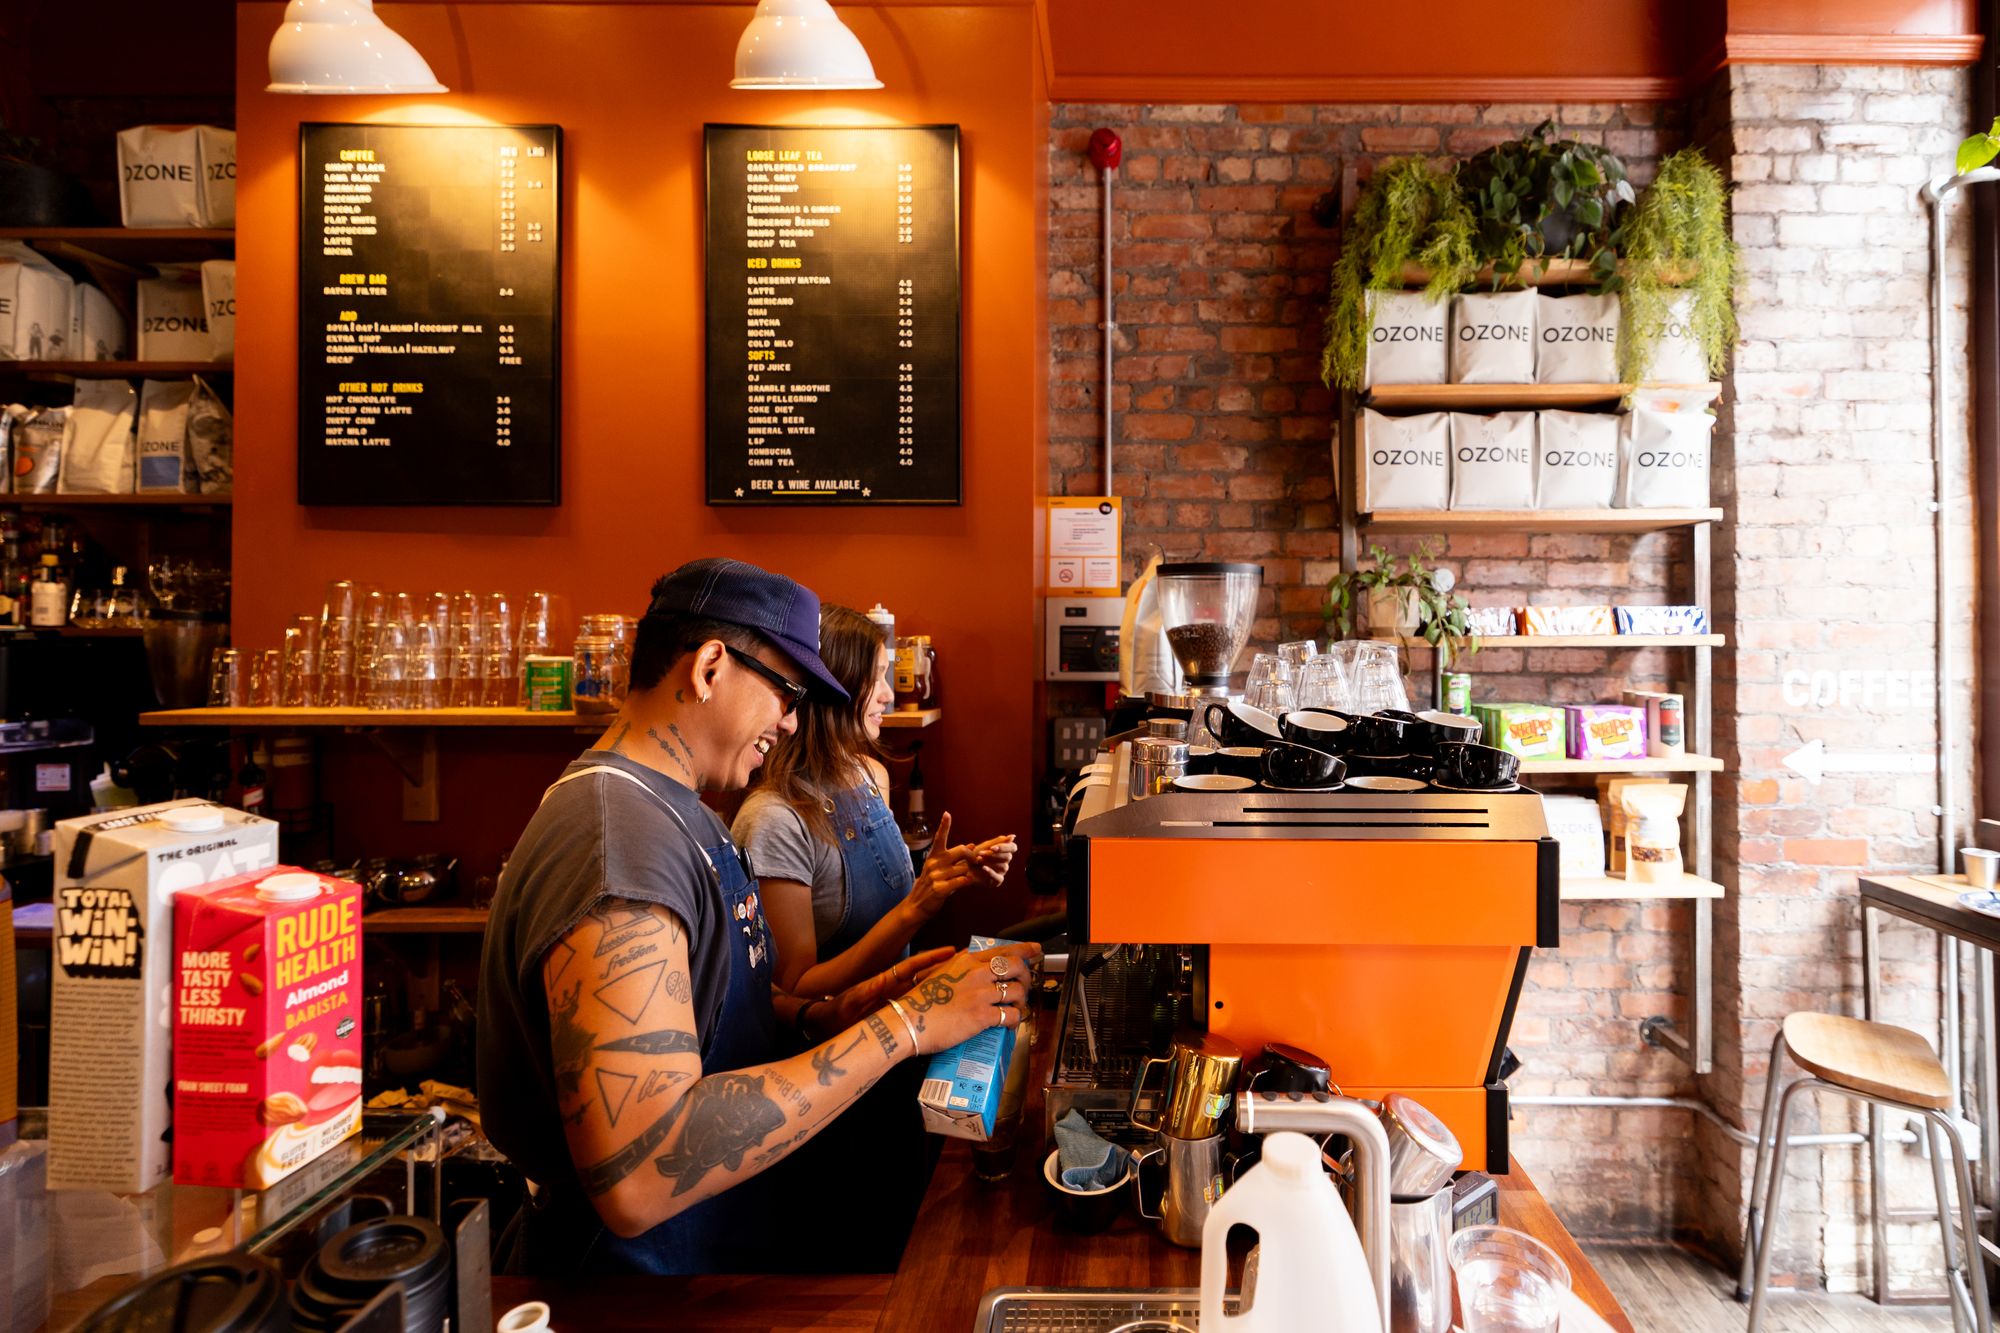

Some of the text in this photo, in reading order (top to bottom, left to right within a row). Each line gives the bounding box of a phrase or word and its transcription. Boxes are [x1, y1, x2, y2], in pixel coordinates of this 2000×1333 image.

[340, 150, 375, 161] COFFEE
[747, 150, 823, 161] LOOSE LEAF TEA
[747, 174, 796, 182] EARL GREY
[747, 184, 799, 192] PEPPERMINT
[324, 216, 347, 224] FLAT
[324, 237, 352, 246] LATTE
[747, 240, 796, 248] DECAF TEA
[747, 258, 802, 268] ICED DRINKS
[340, 274, 387, 285] BREW BAR
[747, 276, 830, 284] BLUEBERRY MATCHA
[324, 286, 387, 296] BATCH FILTER
[748, 287, 775, 295] LATTE
[748, 298, 794, 306] AMERICANO
[340, 311, 358, 321] ADD
[748, 308, 767, 316] CHAI
[748, 318, 780, 326] MATCHA
[748, 329, 776, 337] MOCHA
[1373, 326, 1443, 343] OZONE
[1459, 324, 1529, 342] OZONE
[1543, 327, 1615, 343] OZONE
[326, 335, 381, 343] EXTRA SHOT
[748, 340, 794, 348] COLD MILO
[326, 356, 354, 364] DECAF
[499, 356, 522, 364] FREE
[748, 350, 776, 360] SOFTS
[748, 374, 760, 382] OJ
[339, 382, 424, 393] OTHER HOT DRINKS
[898, 384, 912, 392] 4.5
[326, 396, 396, 404] HOT CHOCOLATE
[326, 406, 412, 414] SPICED CHAI LATTE
[748, 406, 794, 414] COKE DIET
[496, 417, 510, 425] 4.0
[748, 416, 804, 424] GINGER BEER
[898, 416, 912, 424] 4.0
[325, 438, 391, 446] MATCHA LATTE
[496, 438, 510, 446] 4.0
[748, 448, 792, 456] KOMBUCHA
[1457, 446, 1528, 464] OZONE
[748, 458, 794, 466] CHARI TEA
[898, 458, 912, 466] 4.0
[1373, 449, 1444, 467] OZONE
[1545, 450, 1615, 468] OZONE
[751, 480, 860, 490] BEER & WINE AVAILABLE
[1782, 669, 1935, 707] COFFEE
[157, 853, 183, 863] THE
[61, 888, 132, 909] TOTAL
[276, 895, 357, 959] RUDE
[181, 951, 231, 969] MORE
[276, 934, 357, 990] HEALTH
[181, 970, 232, 989] TASTY
[285, 970, 349, 1010] Almond
[180, 988, 222, 1007] LESS
[285, 991, 348, 1031] BARISTA
[179, 1007, 247, 1027] THIRSTY
[199, 1082, 224, 1094] SWEET
[225, 1082, 249, 1094] FOAM
[320, 1124, 352, 1148] SUGAR
[281, 1140, 307, 1161] GLUTEN
[280, 1150, 306, 1171] FREE
